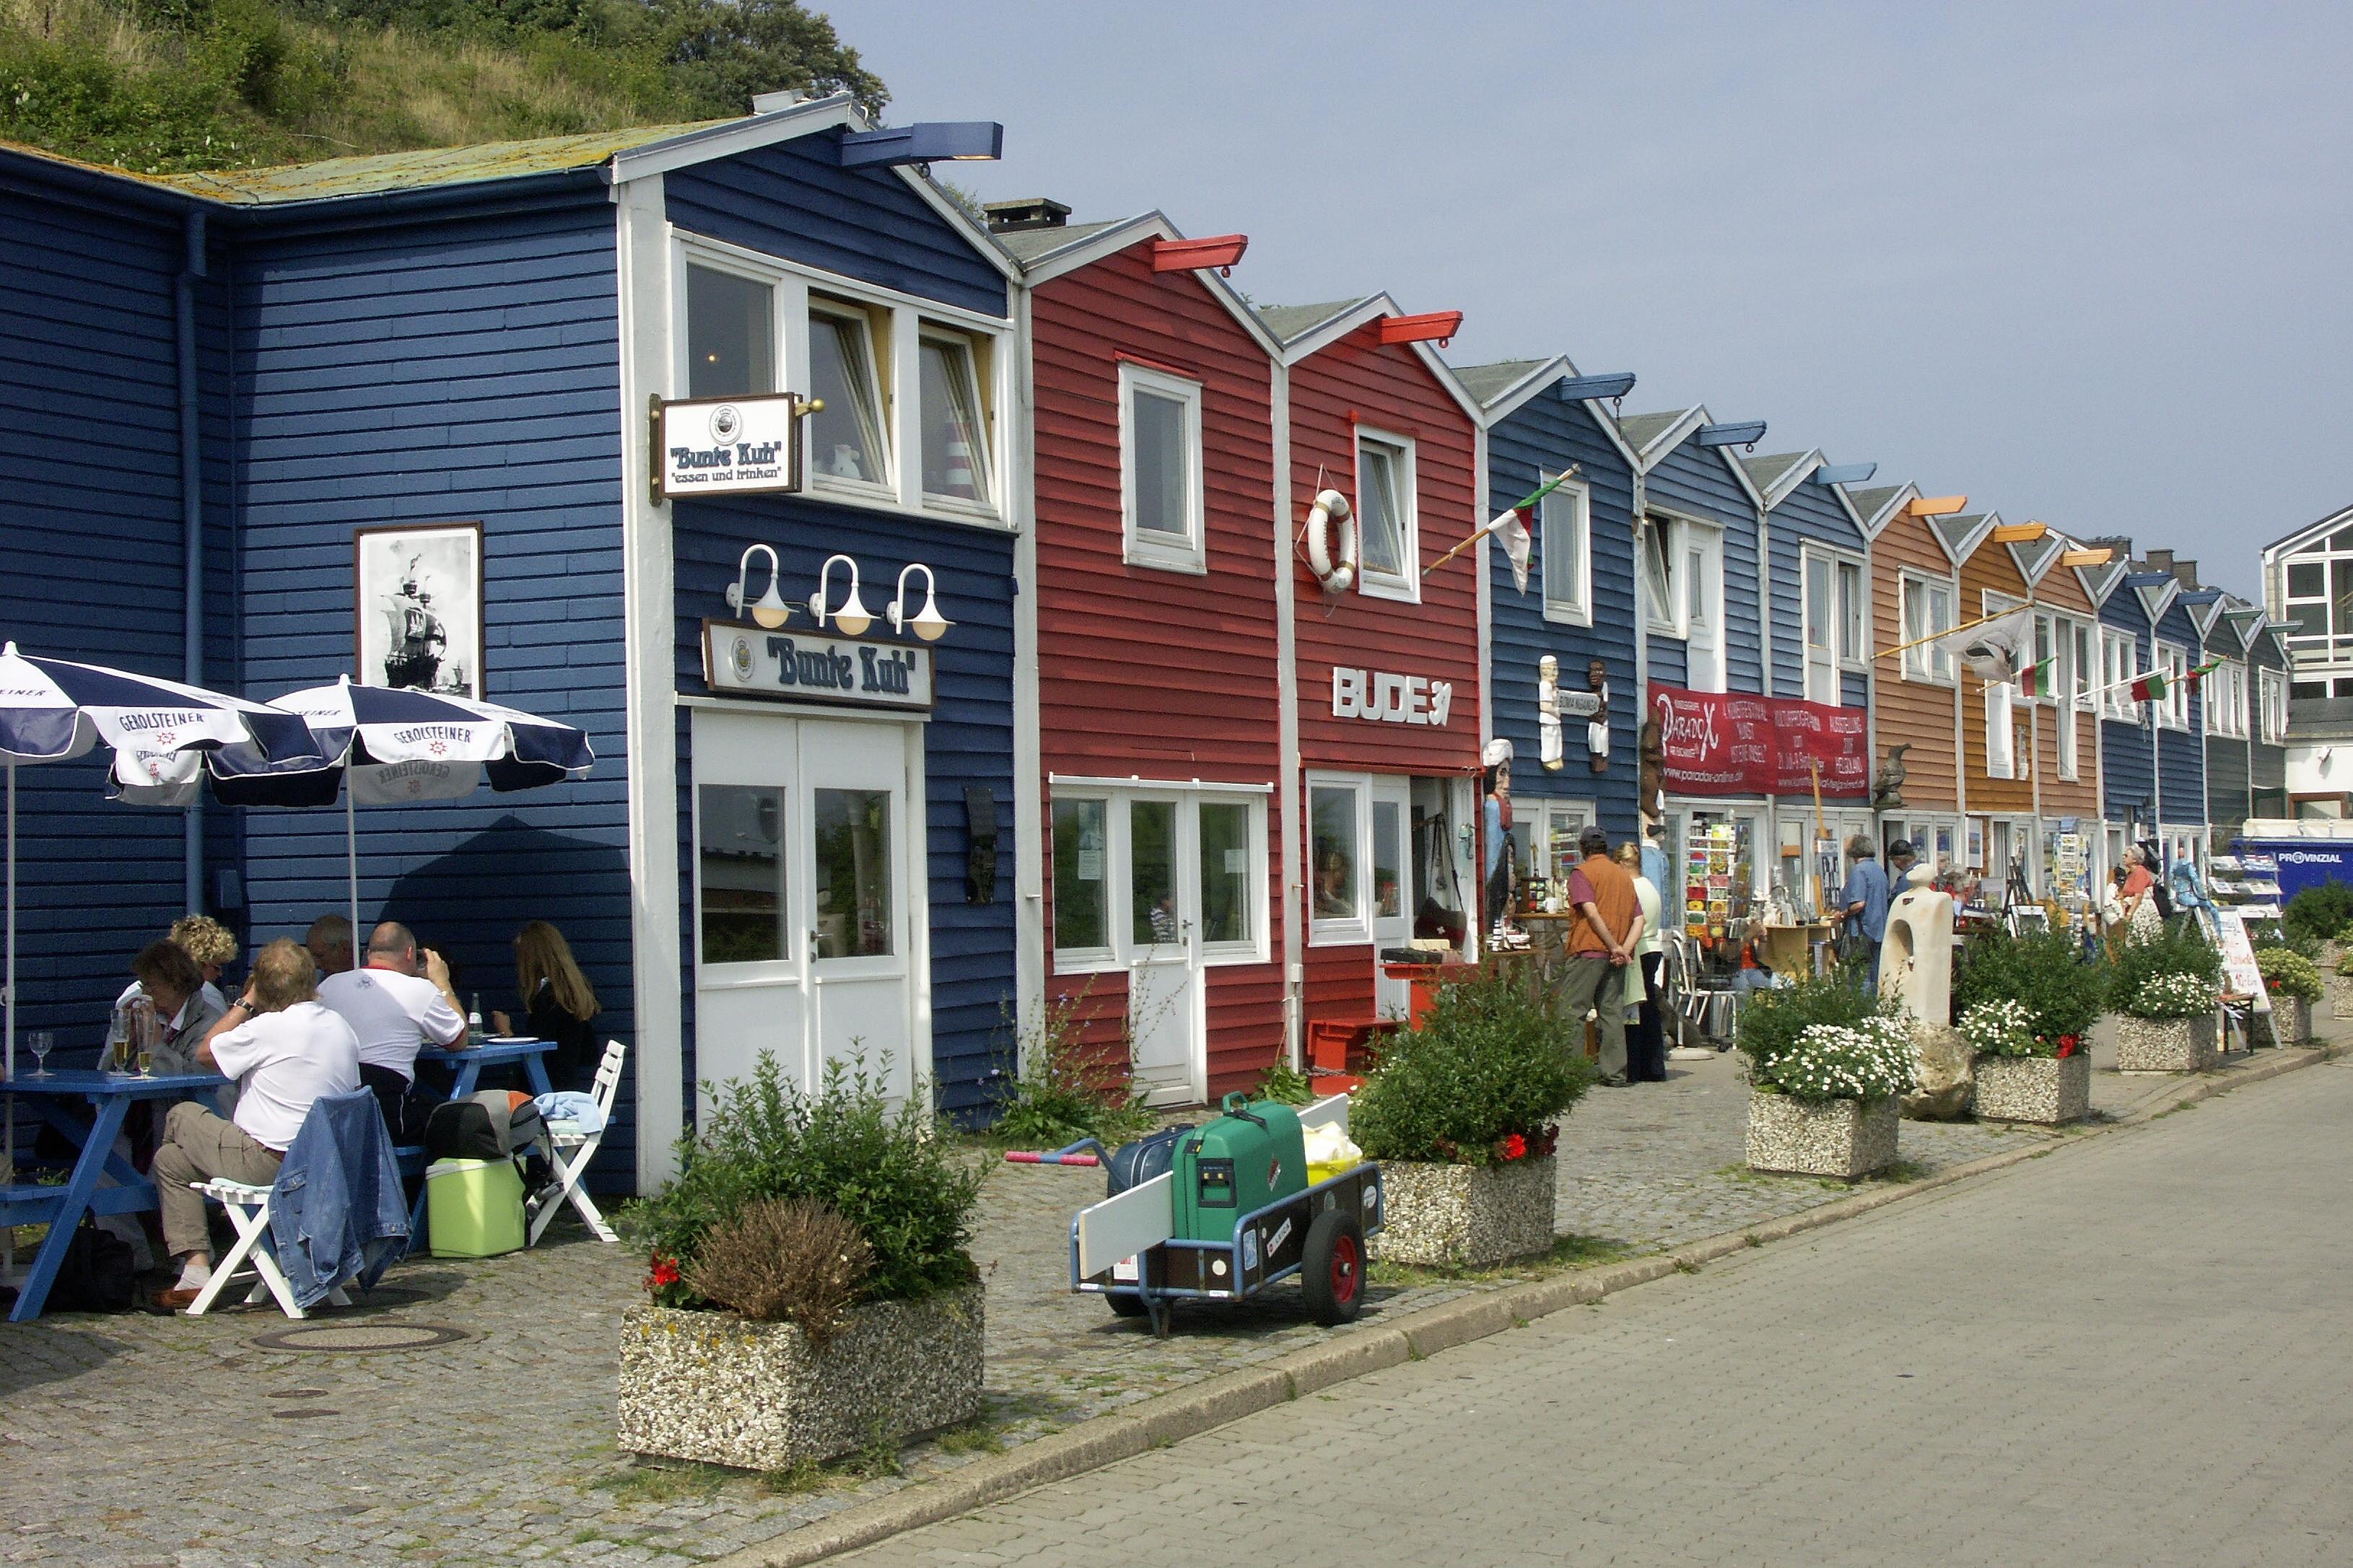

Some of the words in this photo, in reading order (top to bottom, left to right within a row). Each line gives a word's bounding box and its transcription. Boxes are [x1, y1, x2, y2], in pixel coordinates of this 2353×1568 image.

[712, 469, 733, 482] und
[1332, 666, 1428, 724] BUDE
[119, 712, 204, 732] GEROLSTEINER
[393, 726, 472, 744] GEROLSTEINER
[2278, 851, 2343, 864] PROVINZIAL
